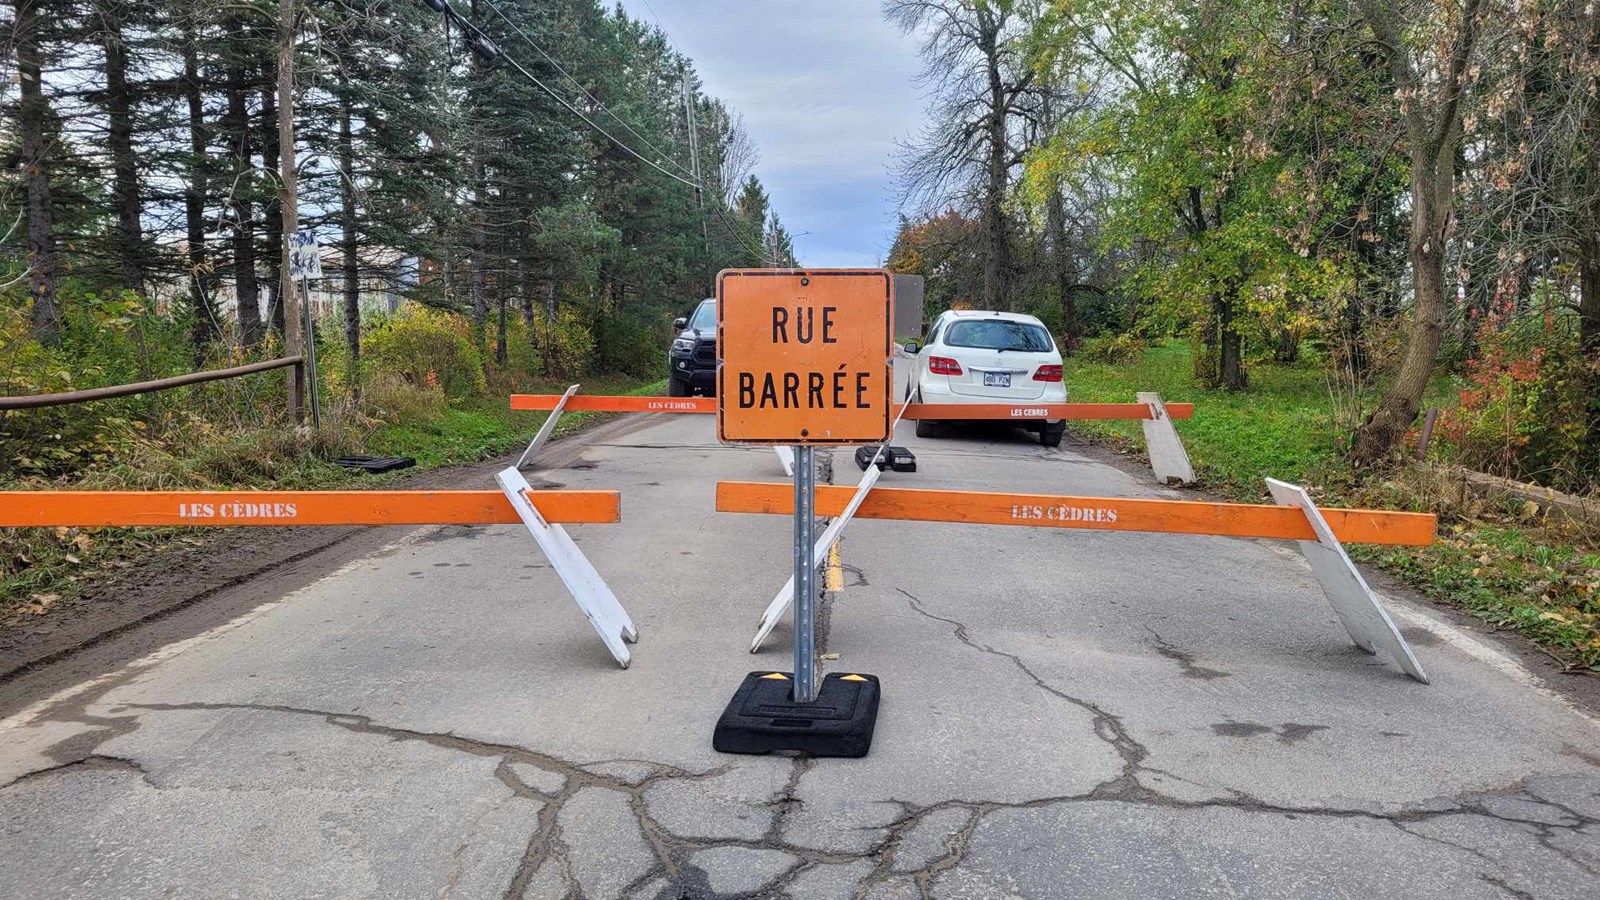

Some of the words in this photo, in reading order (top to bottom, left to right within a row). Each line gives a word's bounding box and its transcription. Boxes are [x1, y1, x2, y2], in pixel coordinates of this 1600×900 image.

[772, 306, 837, 344] RUE
[739, 363, 870, 409] BARRÉE
[1010, 408, 1022, 416] LES
[179, 503, 215, 518] LES
[220, 500, 298, 518] CÈDRES
[1012, 505, 1043, 519] LES
[1047, 503, 1118, 523] CÈDRES
